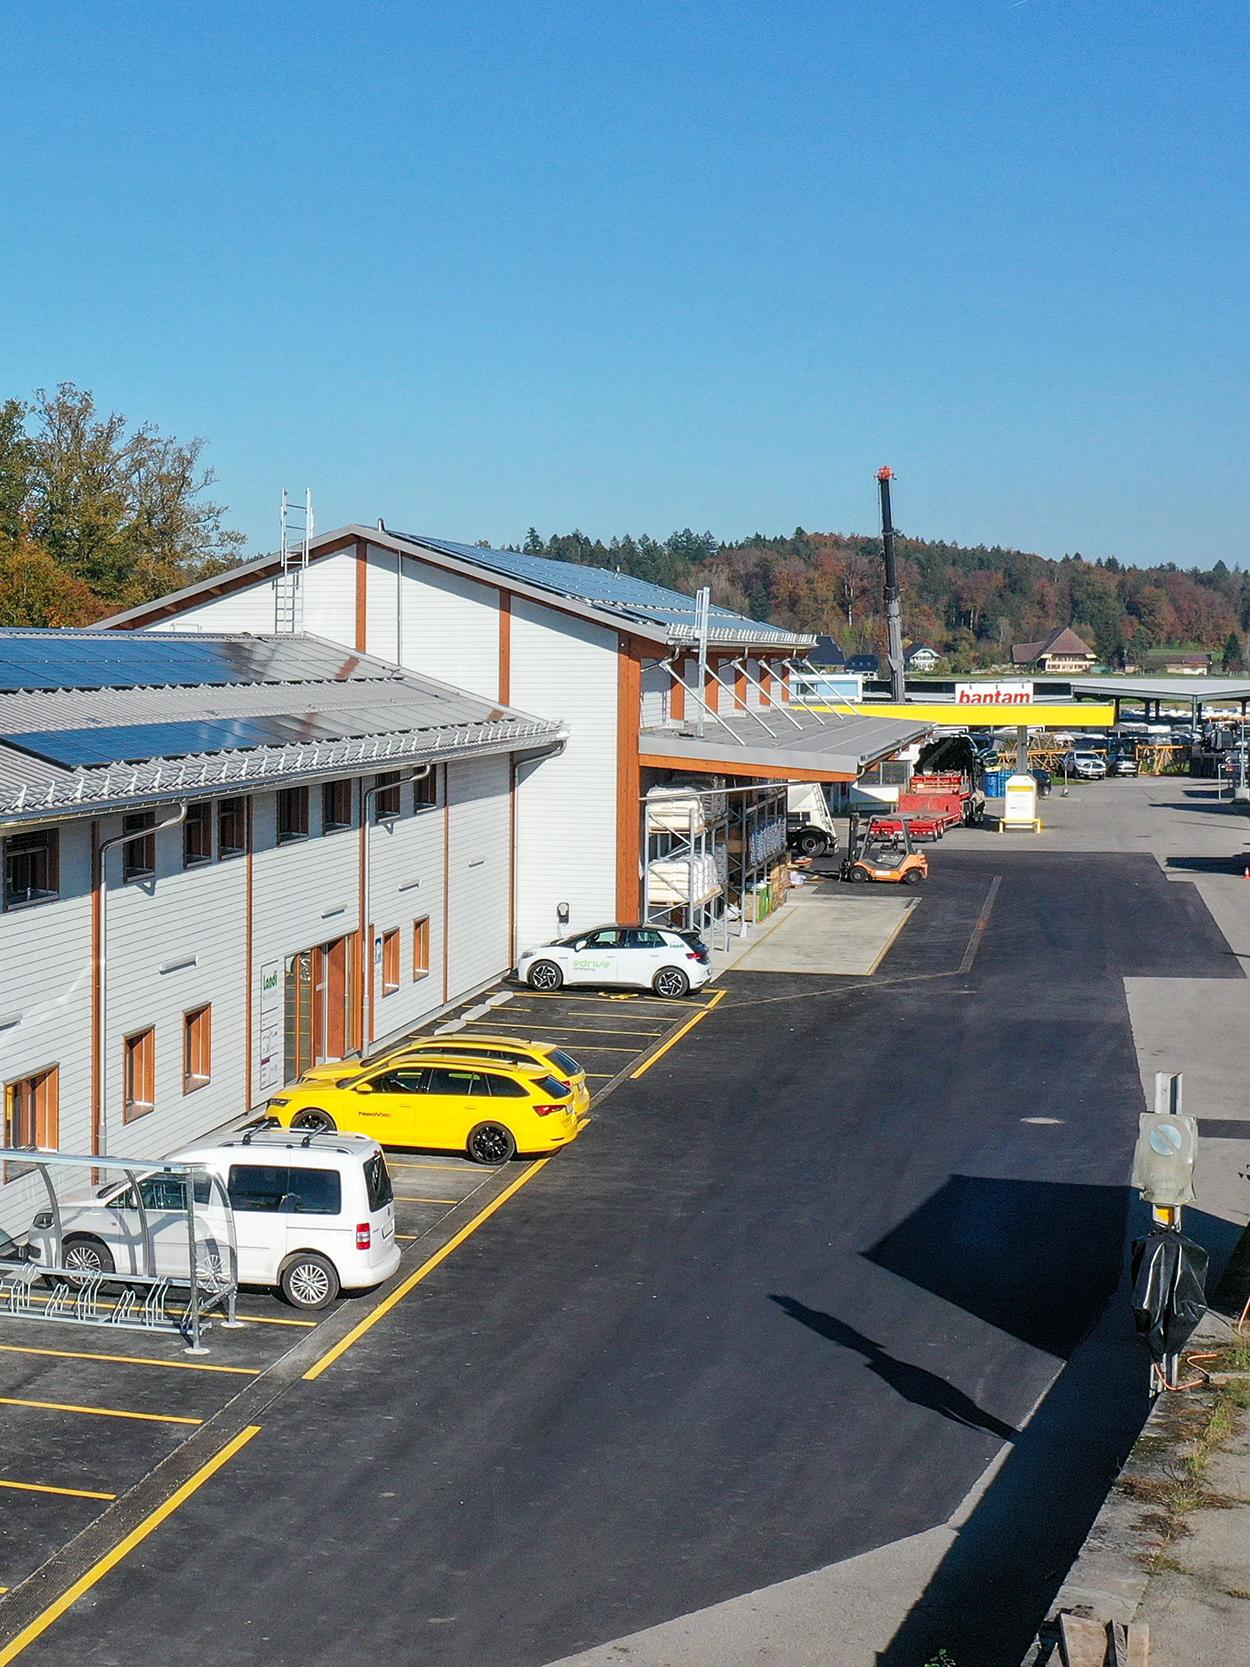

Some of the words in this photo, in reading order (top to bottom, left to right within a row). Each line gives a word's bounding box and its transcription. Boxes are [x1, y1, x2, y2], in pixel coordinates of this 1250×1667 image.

[959, 690, 1031, 704] bantam
[572, 958, 611, 968] edrive
[263, 970, 278, 991] Landi
